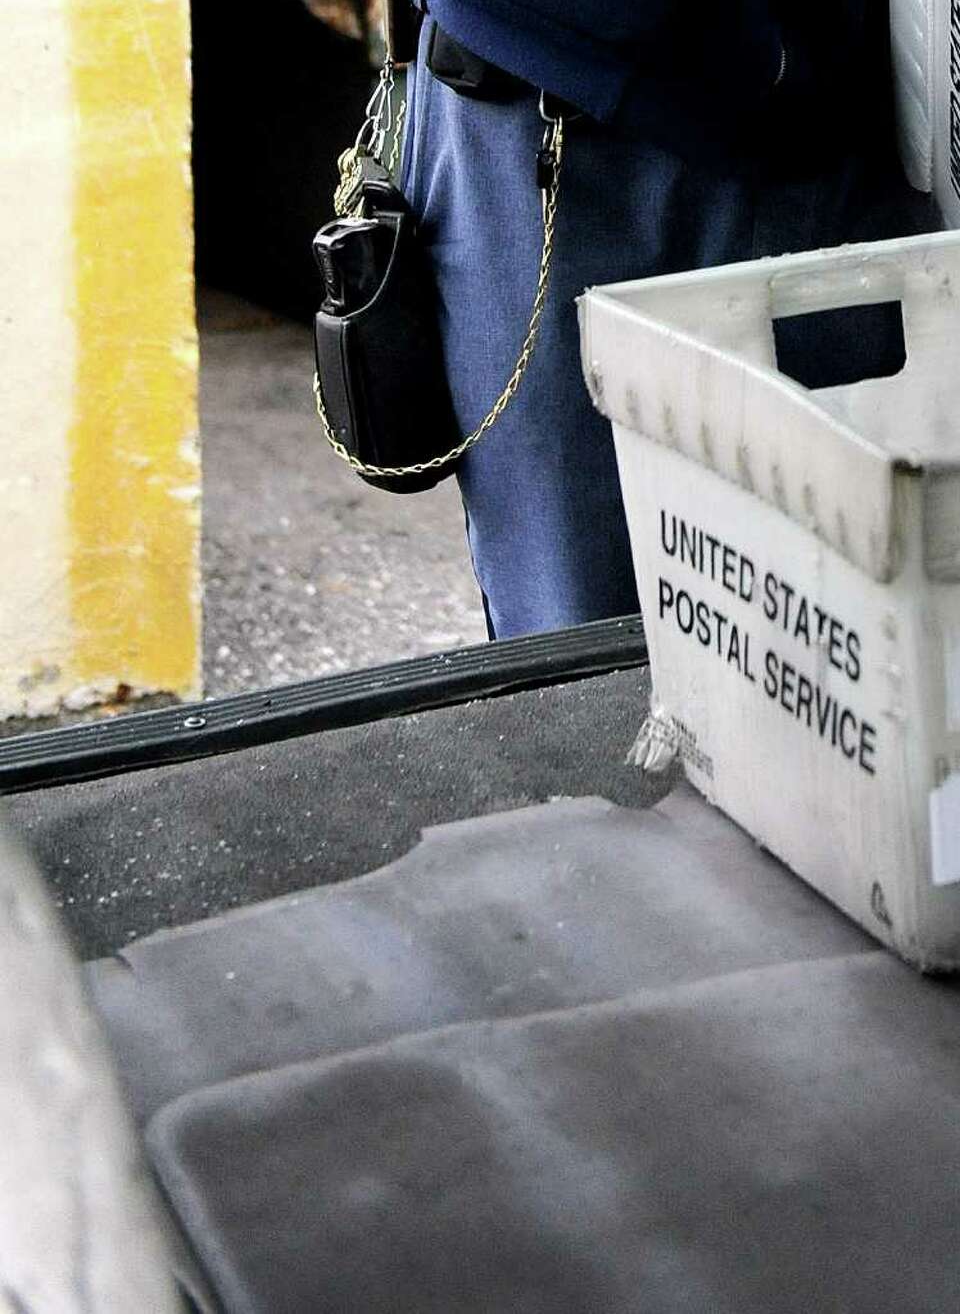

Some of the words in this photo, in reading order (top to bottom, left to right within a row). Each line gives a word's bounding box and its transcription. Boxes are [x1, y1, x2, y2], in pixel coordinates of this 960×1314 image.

[659, 575, 756, 683] POSTAL
[763, 649, 876, 777] SERVICE
[660, 509, 755, 603] UNITED
[763, 572, 862, 682] STATES
